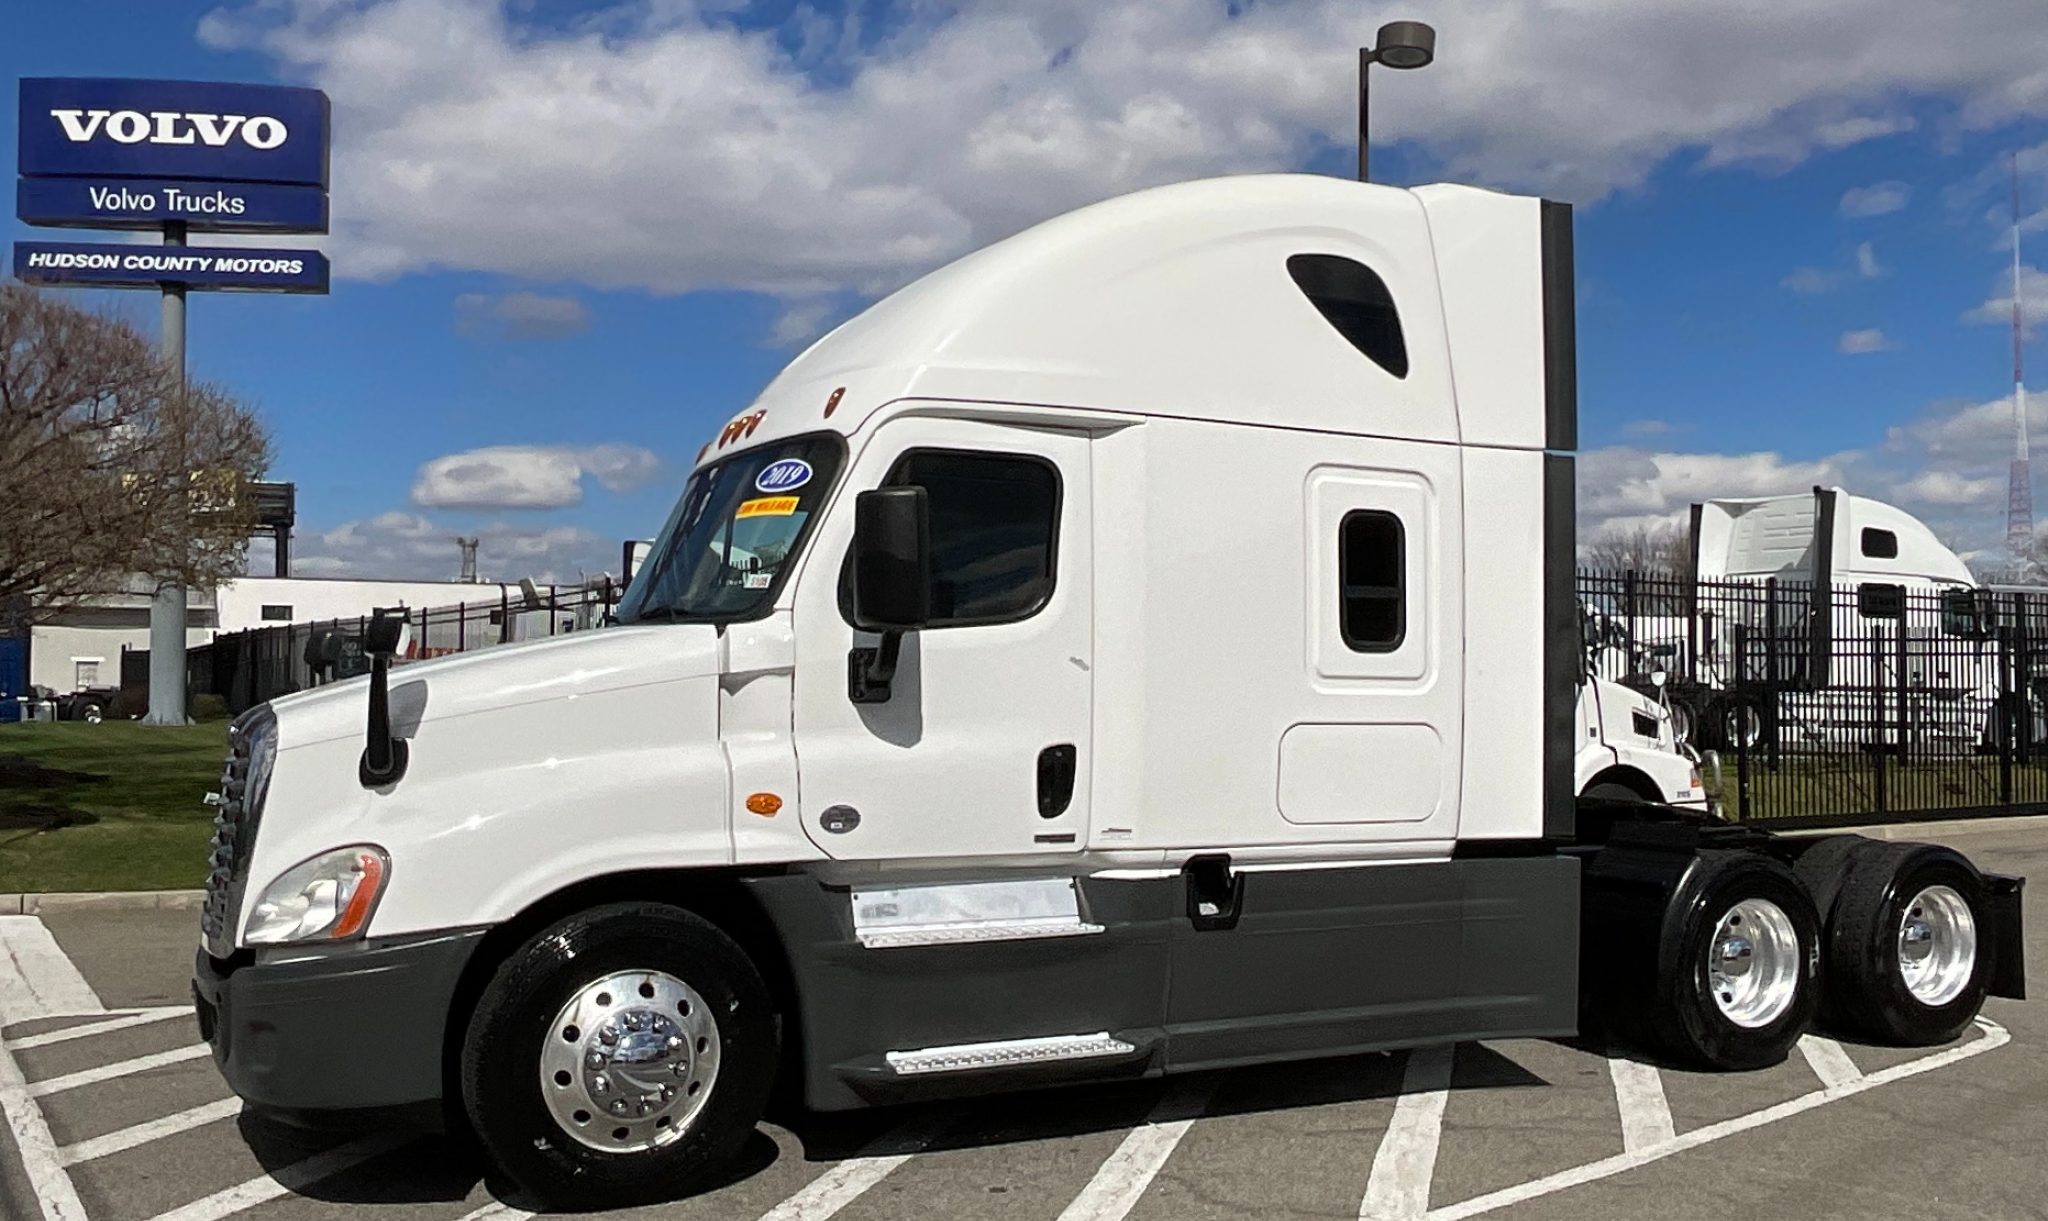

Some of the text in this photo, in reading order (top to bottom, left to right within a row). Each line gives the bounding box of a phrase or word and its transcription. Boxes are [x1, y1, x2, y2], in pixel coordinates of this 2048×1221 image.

[51, 110, 288, 149] VOLVO
[90, 187, 245, 214] Volvo Trucks
[29, 253, 303, 274] HUDSON COUNTY MOTORS
[761, 465, 804, 486] 2019
